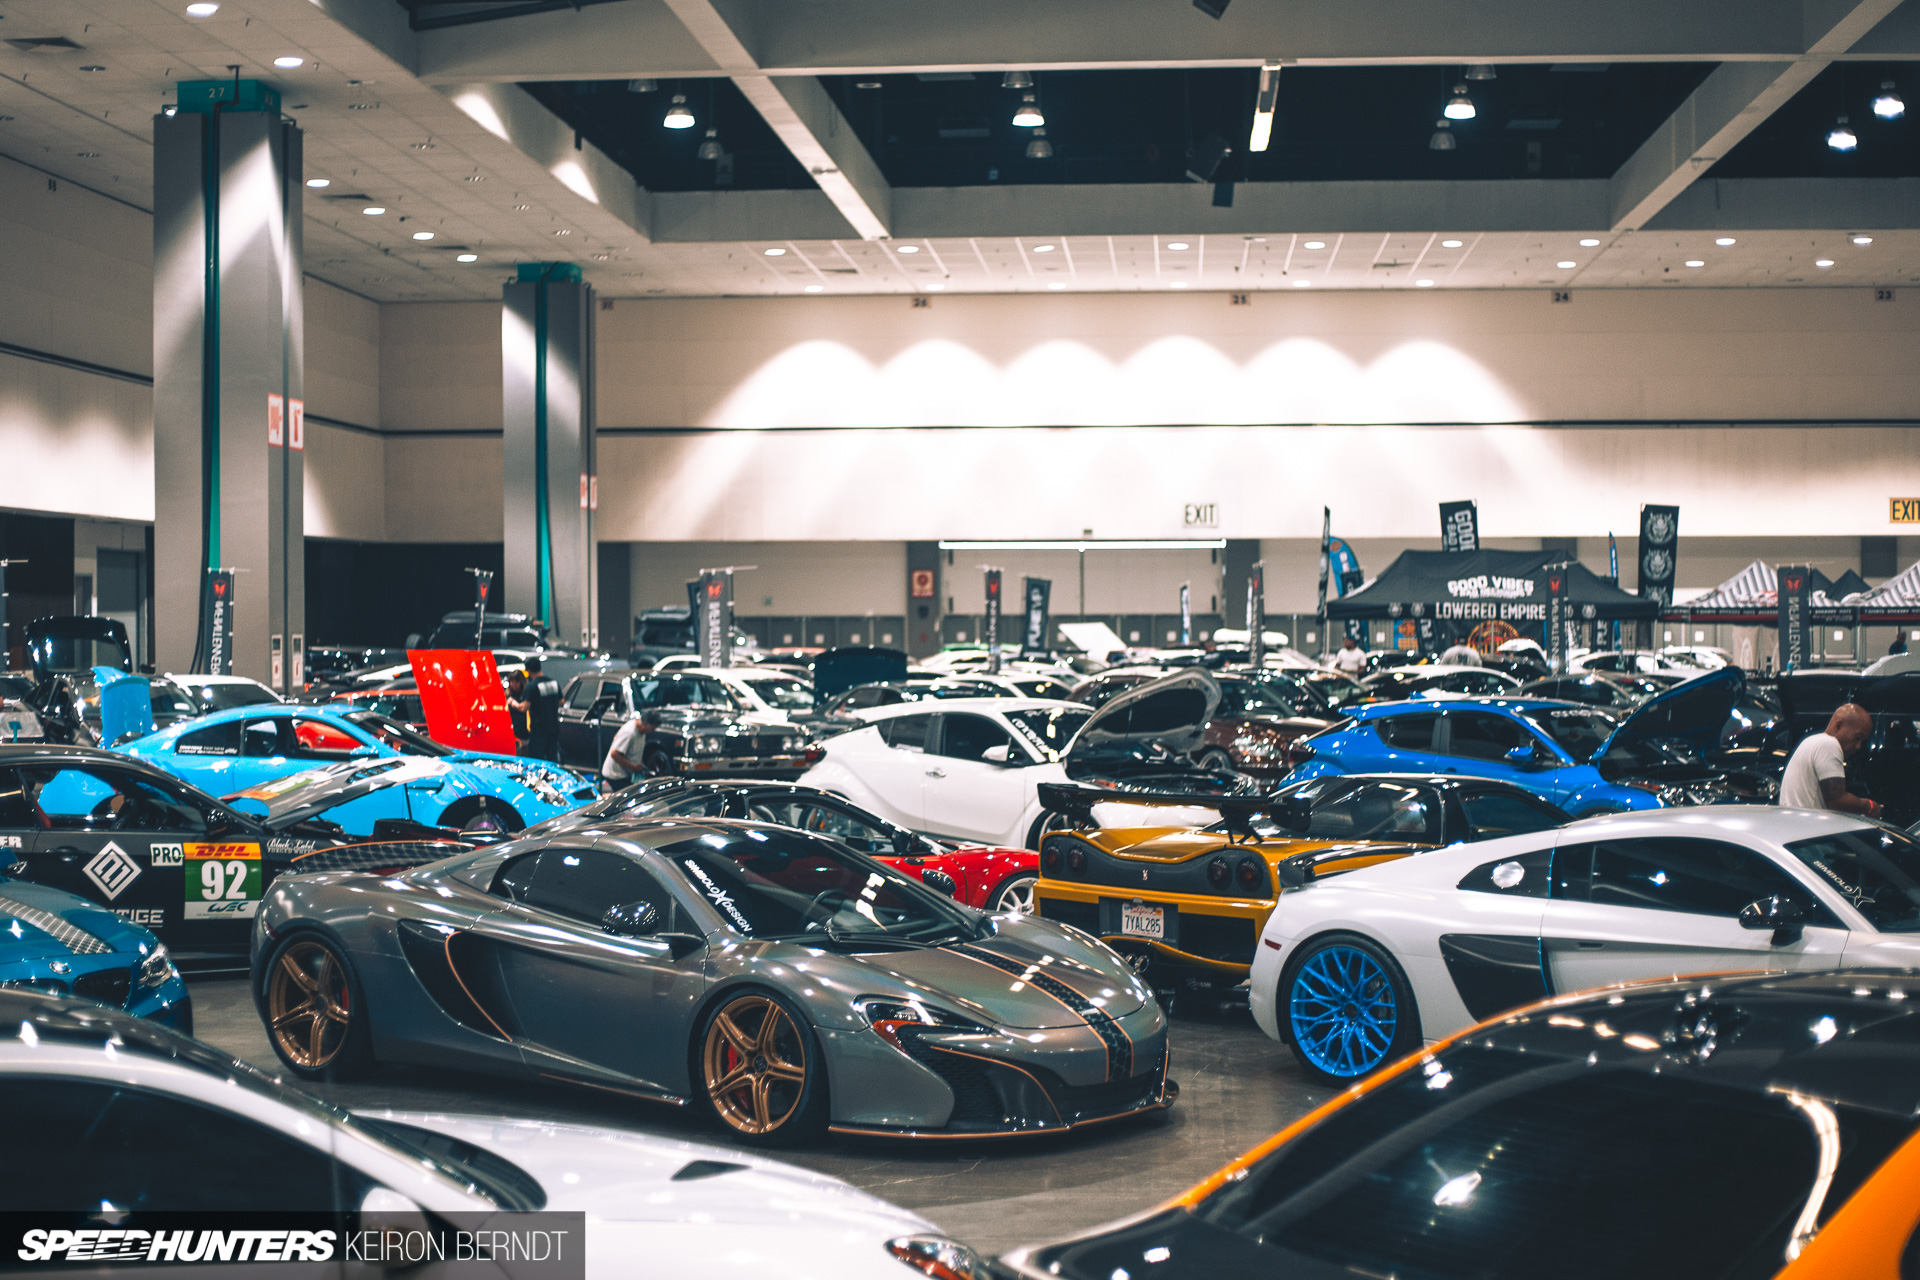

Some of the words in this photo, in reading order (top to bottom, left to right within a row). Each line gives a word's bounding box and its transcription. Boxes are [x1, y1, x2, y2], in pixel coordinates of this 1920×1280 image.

[208, 86, 226, 98] 27
[1185, 503, 1216, 524] EXIT
[1447, 575, 1488, 594] GOOD
[1435, 602, 1497, 620] LOWERED
[1500, 602, 1547, 621] EMPIRE
[195, 845, 251, 857] DHL
[267, 838, 293, 848] Black
[295, 839, 316, 849] Label
[152, 846, 182, 863] PRO
[201, 860, 248, 900] 92
[207, 901, 249, 912] WEC
[1124, 914, 1161, 934] 7YAL285
